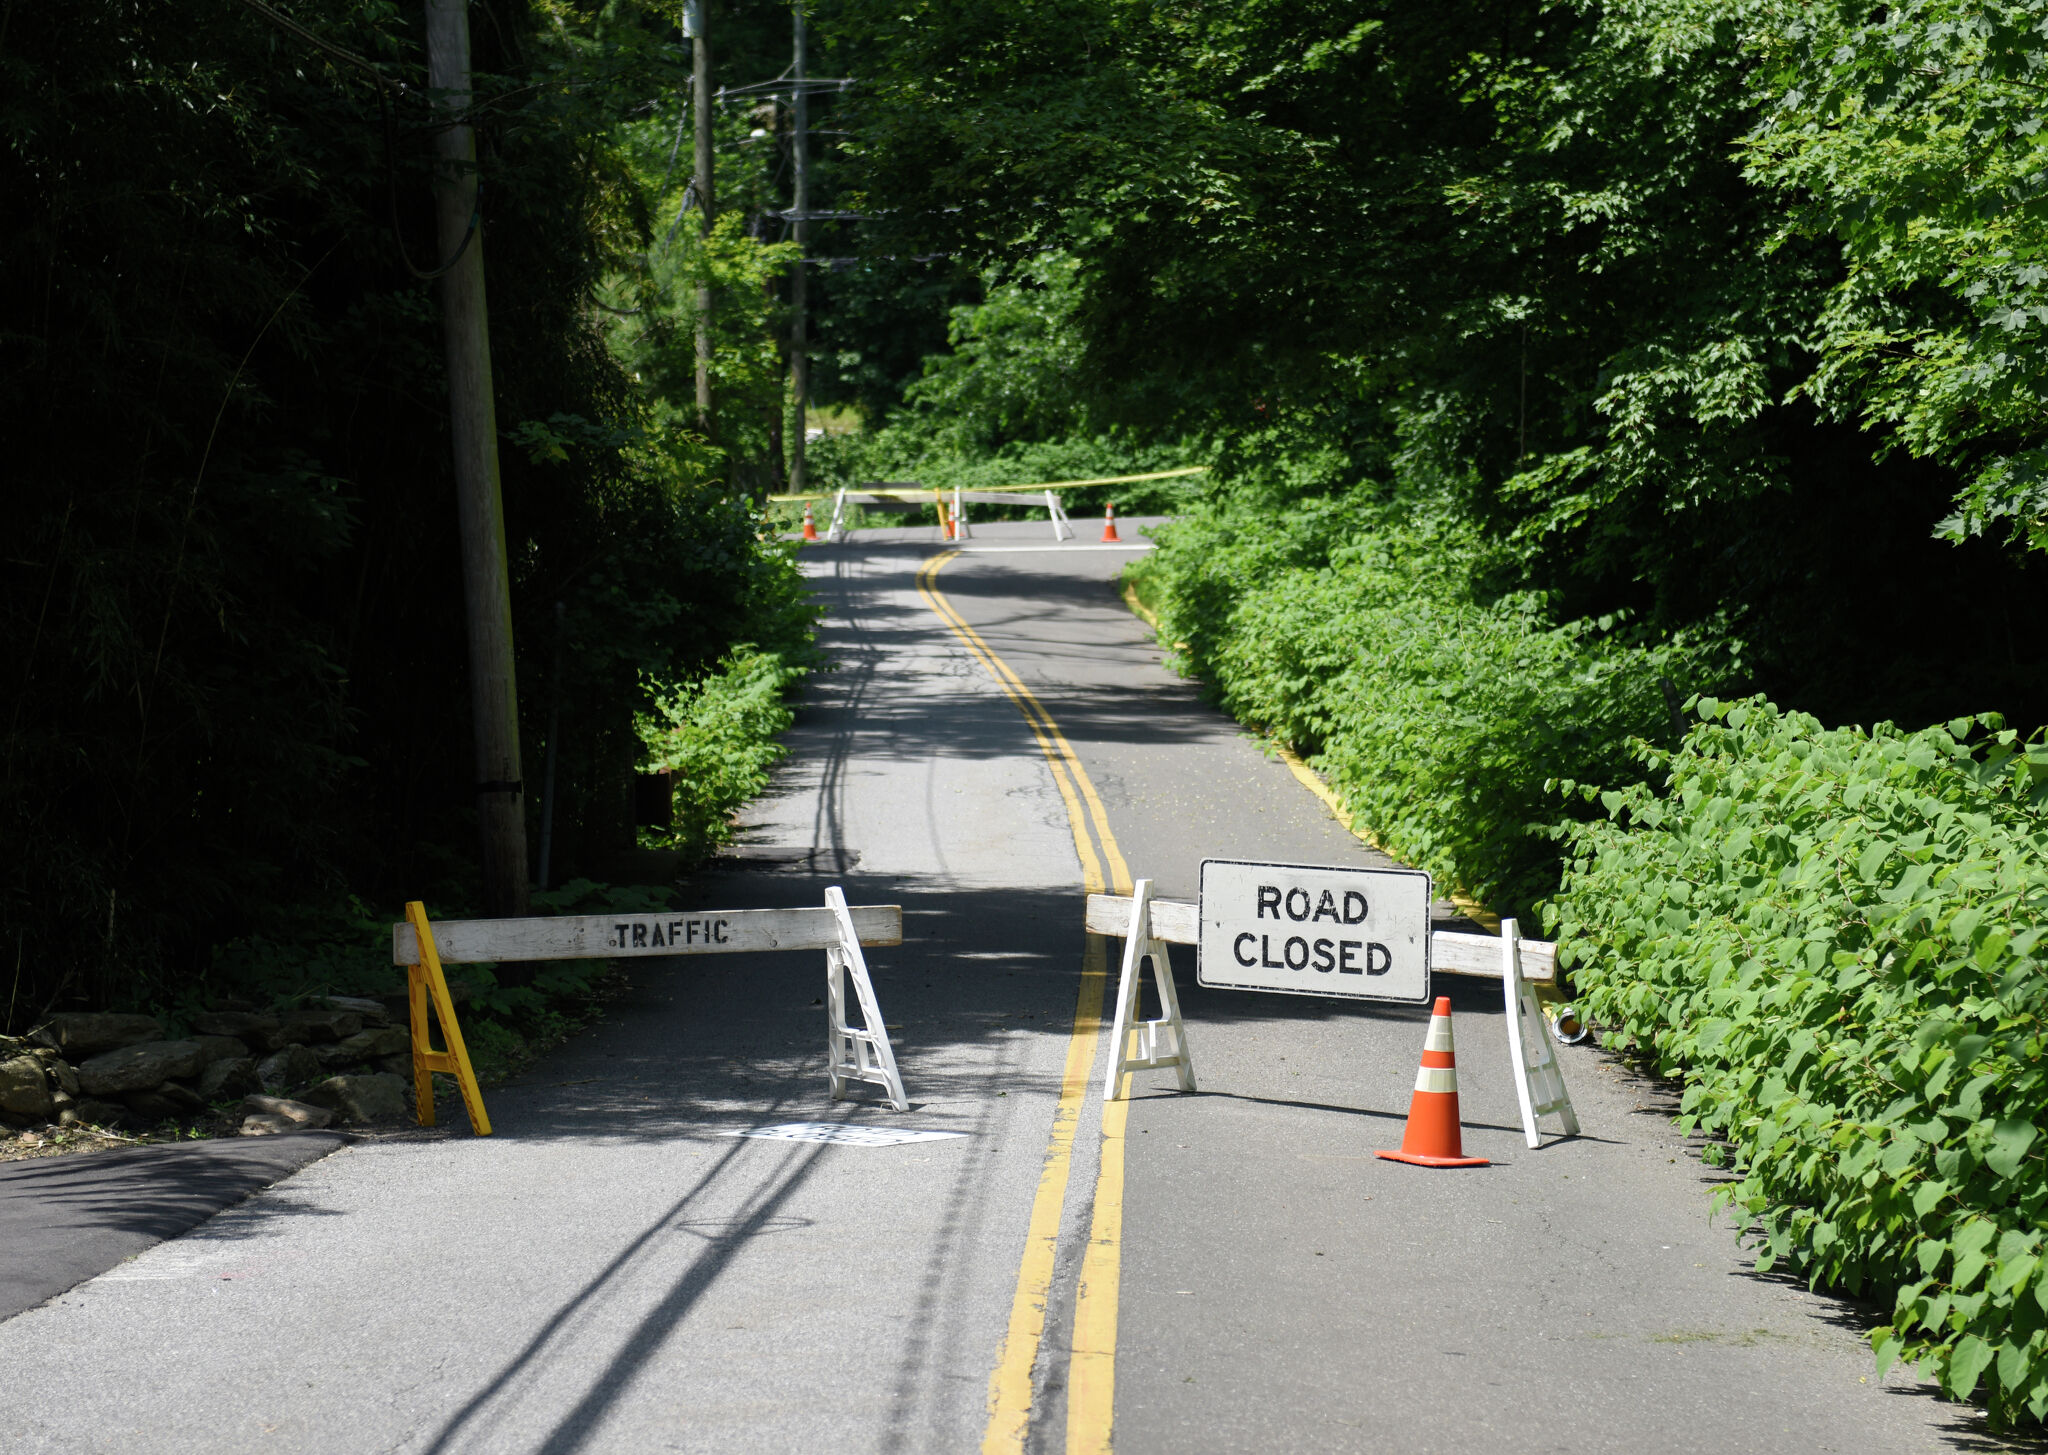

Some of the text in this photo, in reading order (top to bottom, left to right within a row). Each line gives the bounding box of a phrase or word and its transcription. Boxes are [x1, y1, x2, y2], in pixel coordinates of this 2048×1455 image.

[1257, 885, 1369, 925] ROAD
[615, 919, 728, 948] TRAFFIC
[1233, 932, 1392, 976] CLOSED
